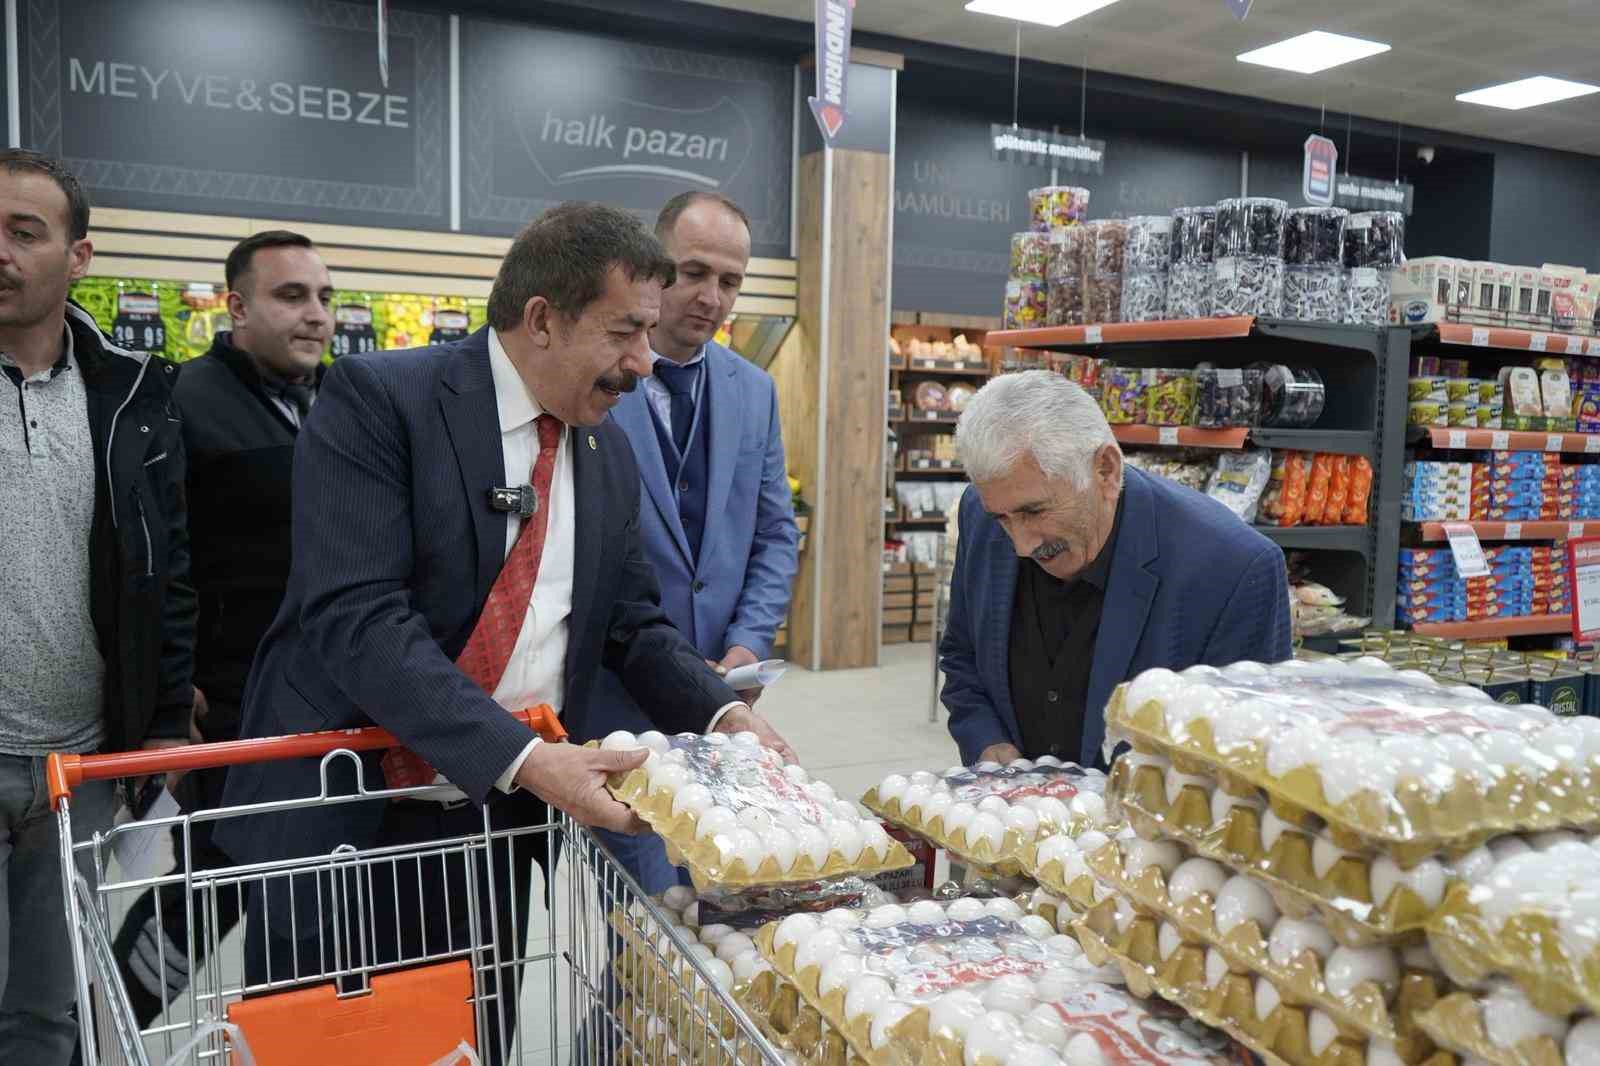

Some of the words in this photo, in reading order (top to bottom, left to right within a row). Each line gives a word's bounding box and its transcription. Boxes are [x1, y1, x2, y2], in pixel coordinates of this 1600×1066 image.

[69, 58, 409, 128] MEYVE&SEBZE
[541, 112, 615, 149] halk
[623, 125, 729, 161] pazarı
